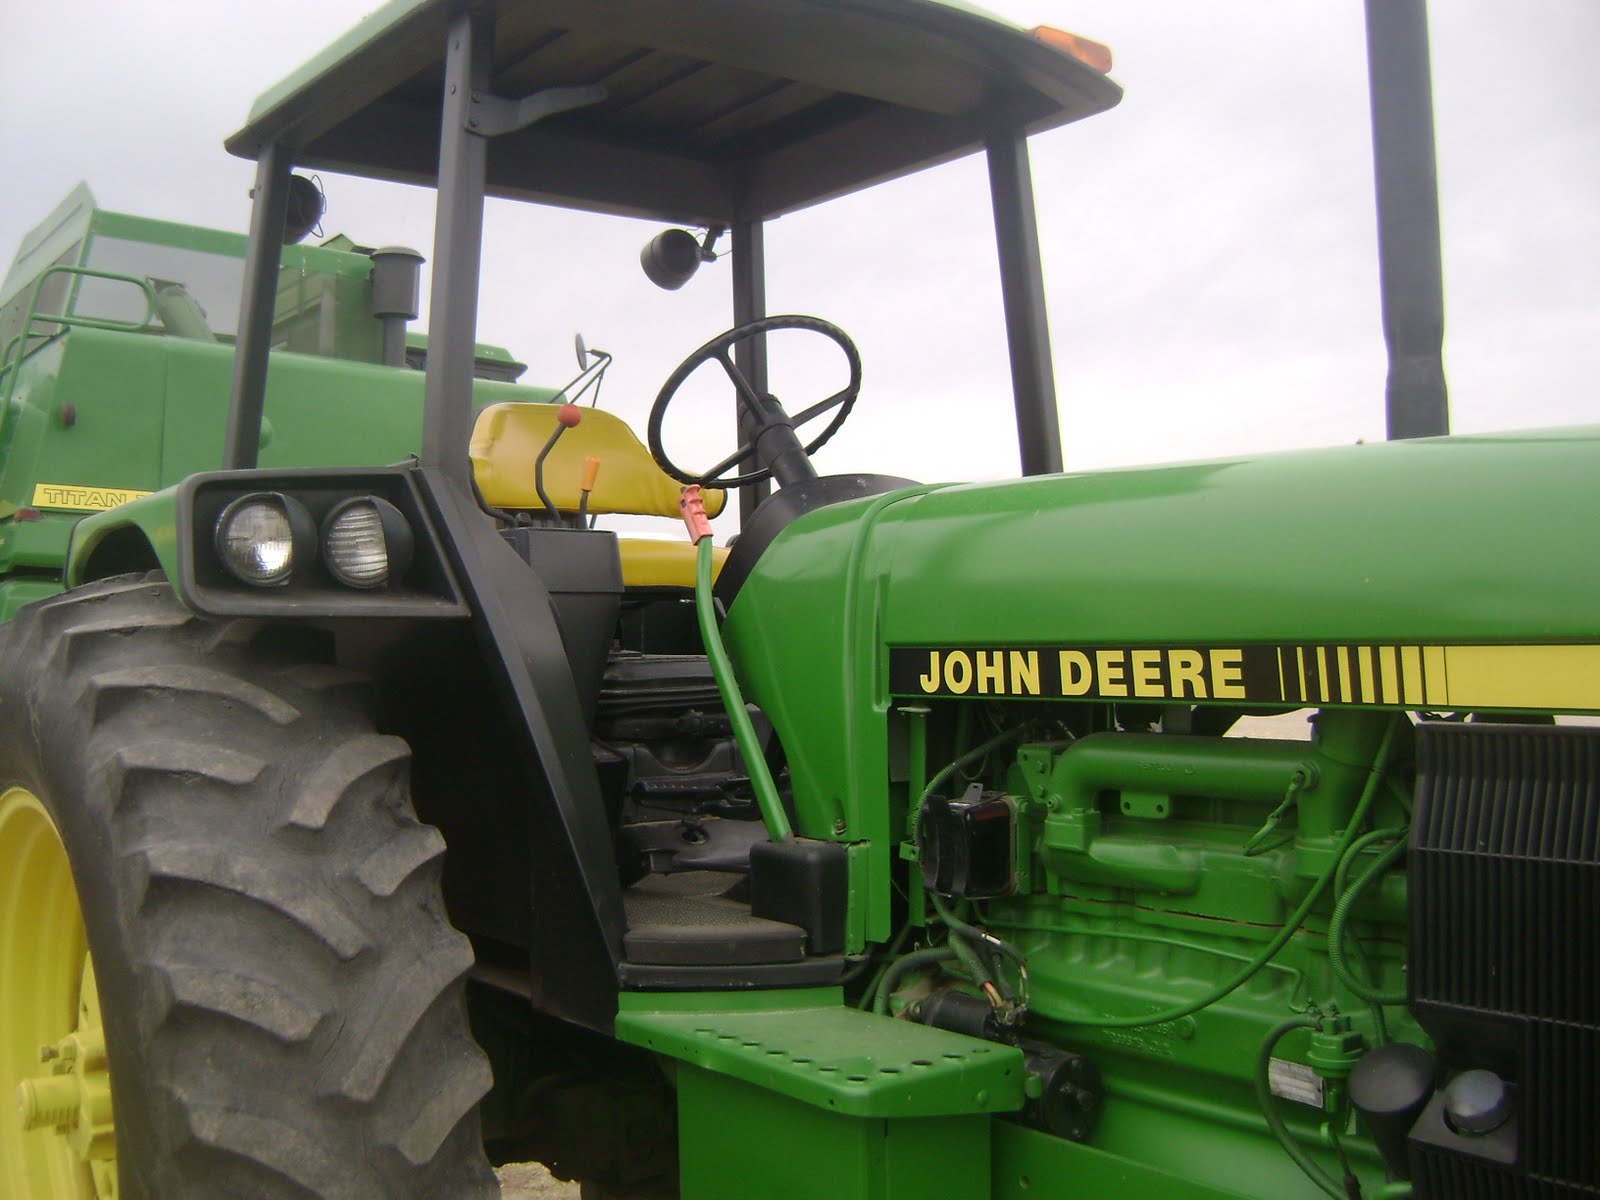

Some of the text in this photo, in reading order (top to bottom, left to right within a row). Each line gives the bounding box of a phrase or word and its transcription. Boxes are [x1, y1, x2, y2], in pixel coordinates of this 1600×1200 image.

[44, 488, 127, 508] TITAN
[919, 649, 1246, 699] JOHN DEERE
